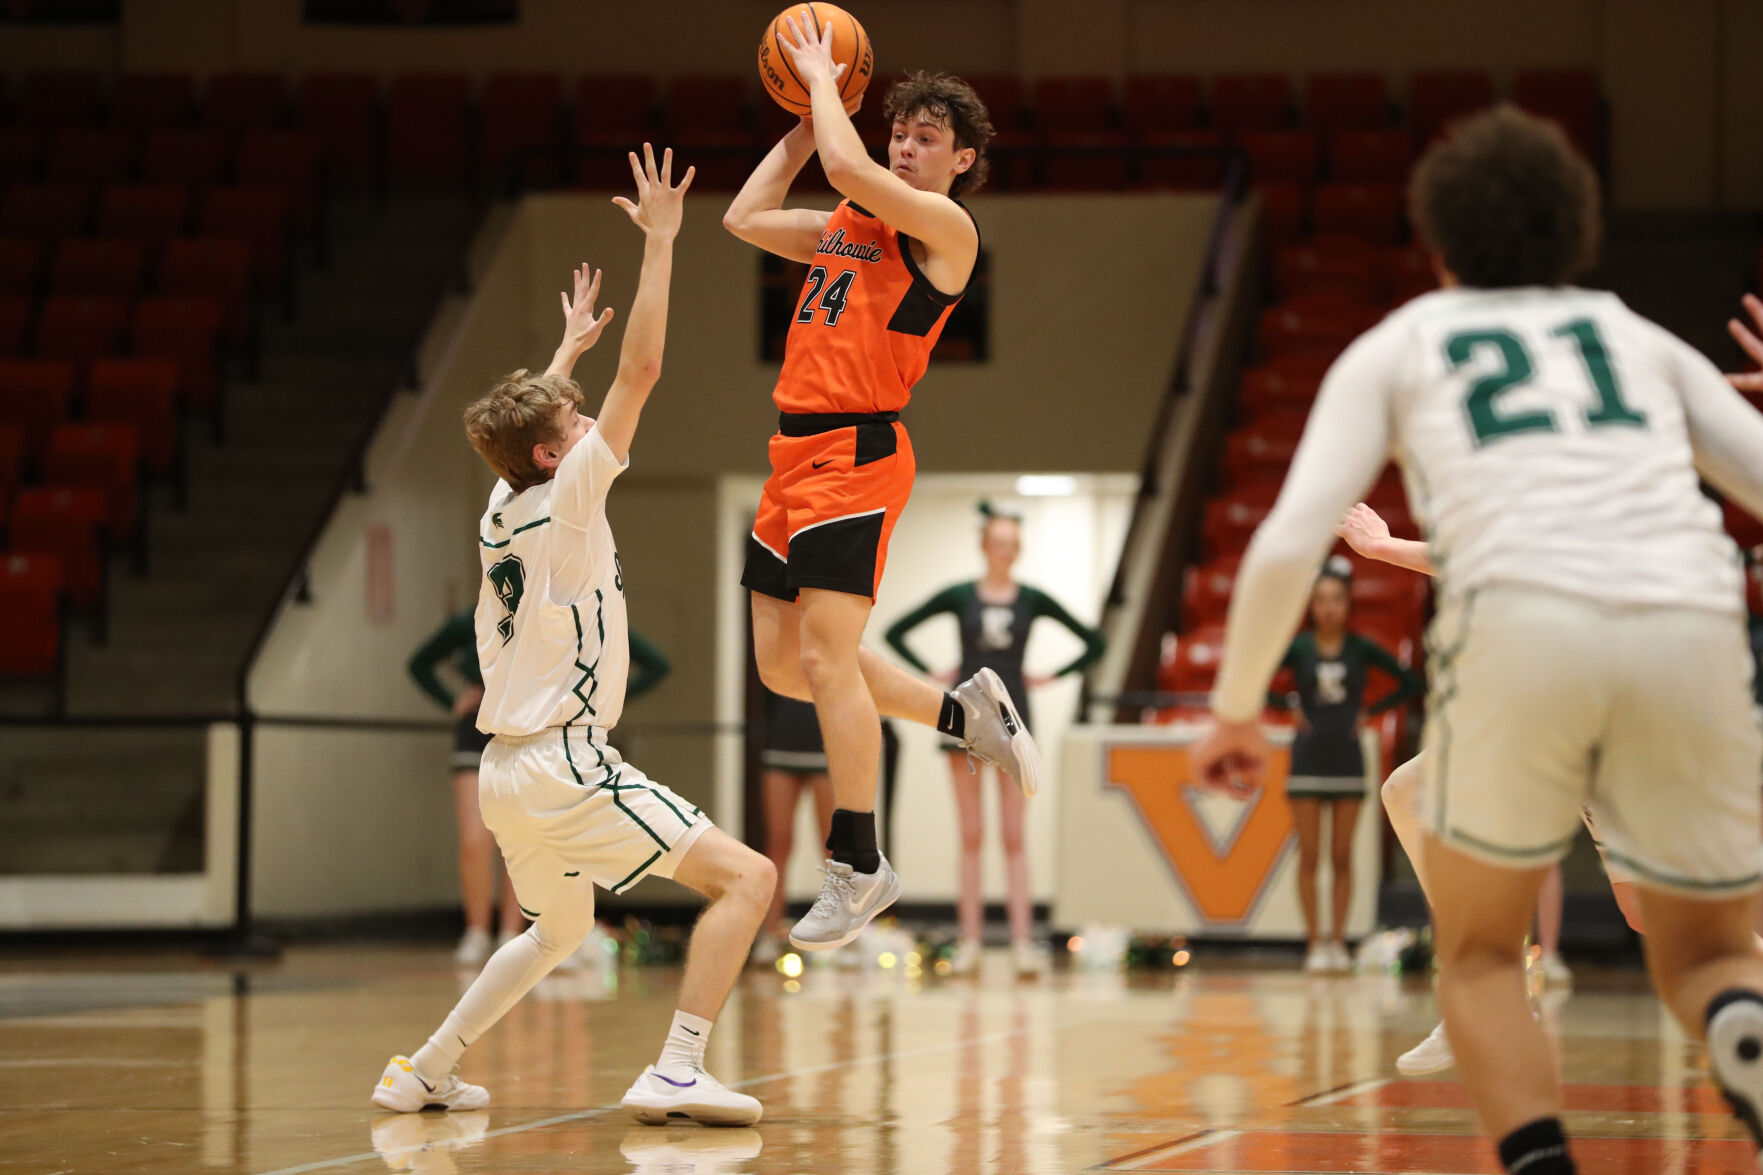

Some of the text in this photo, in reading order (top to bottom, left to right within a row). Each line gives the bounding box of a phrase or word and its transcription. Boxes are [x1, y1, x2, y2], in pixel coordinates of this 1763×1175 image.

[797, 265, 857, 327] 24
[1446, 317, 1647, 446] 21
[1103, 743, 1298, 924] V
